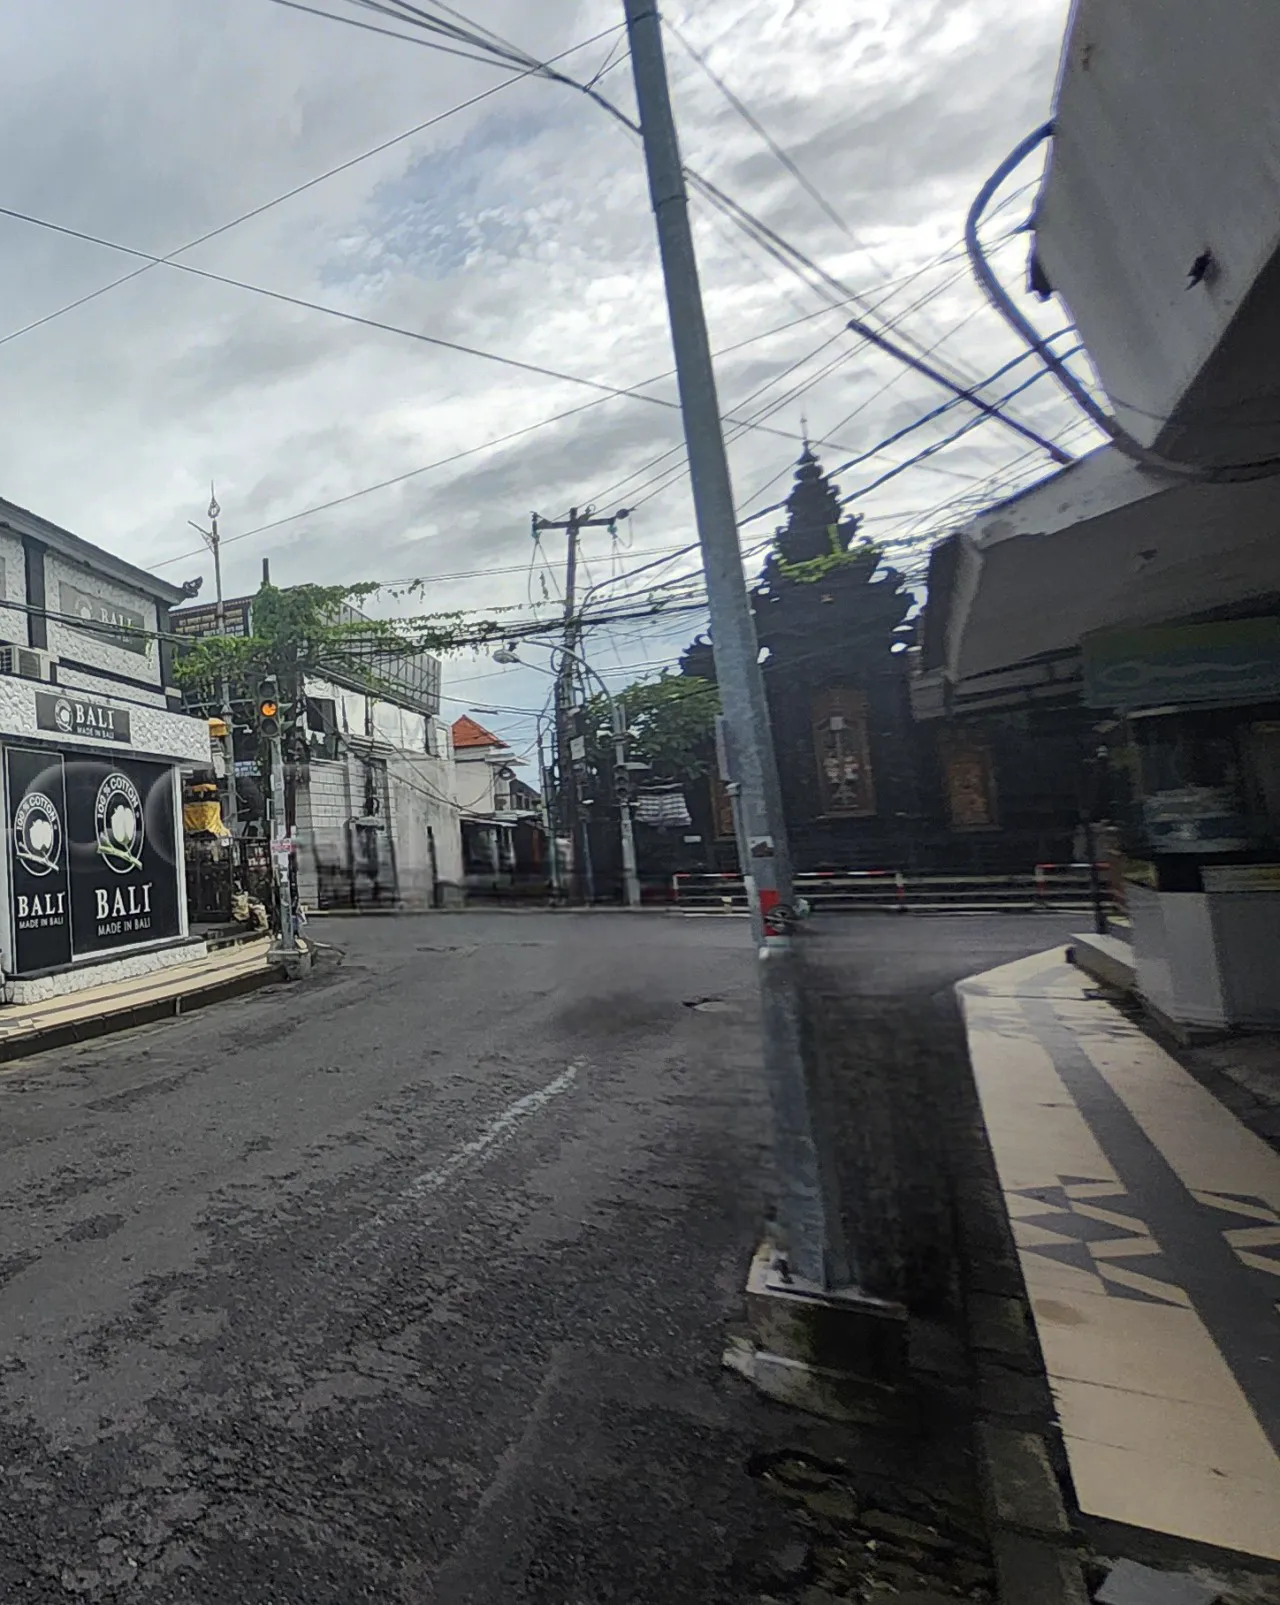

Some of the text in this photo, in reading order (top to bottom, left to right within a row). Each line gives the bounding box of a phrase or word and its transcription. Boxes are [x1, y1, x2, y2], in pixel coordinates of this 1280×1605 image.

[75, 704, 114, 729] BALI
[110, 777, 139, 808] COTTON
[29, 796, 57, 822] COTTON
[17, 893, 64, 917] BALI
[95, 885, 151, 919] BALI
[19, 916, 64, 929] MADE IN BALI
[98, 917, 151, 936] MADE IN BALI
